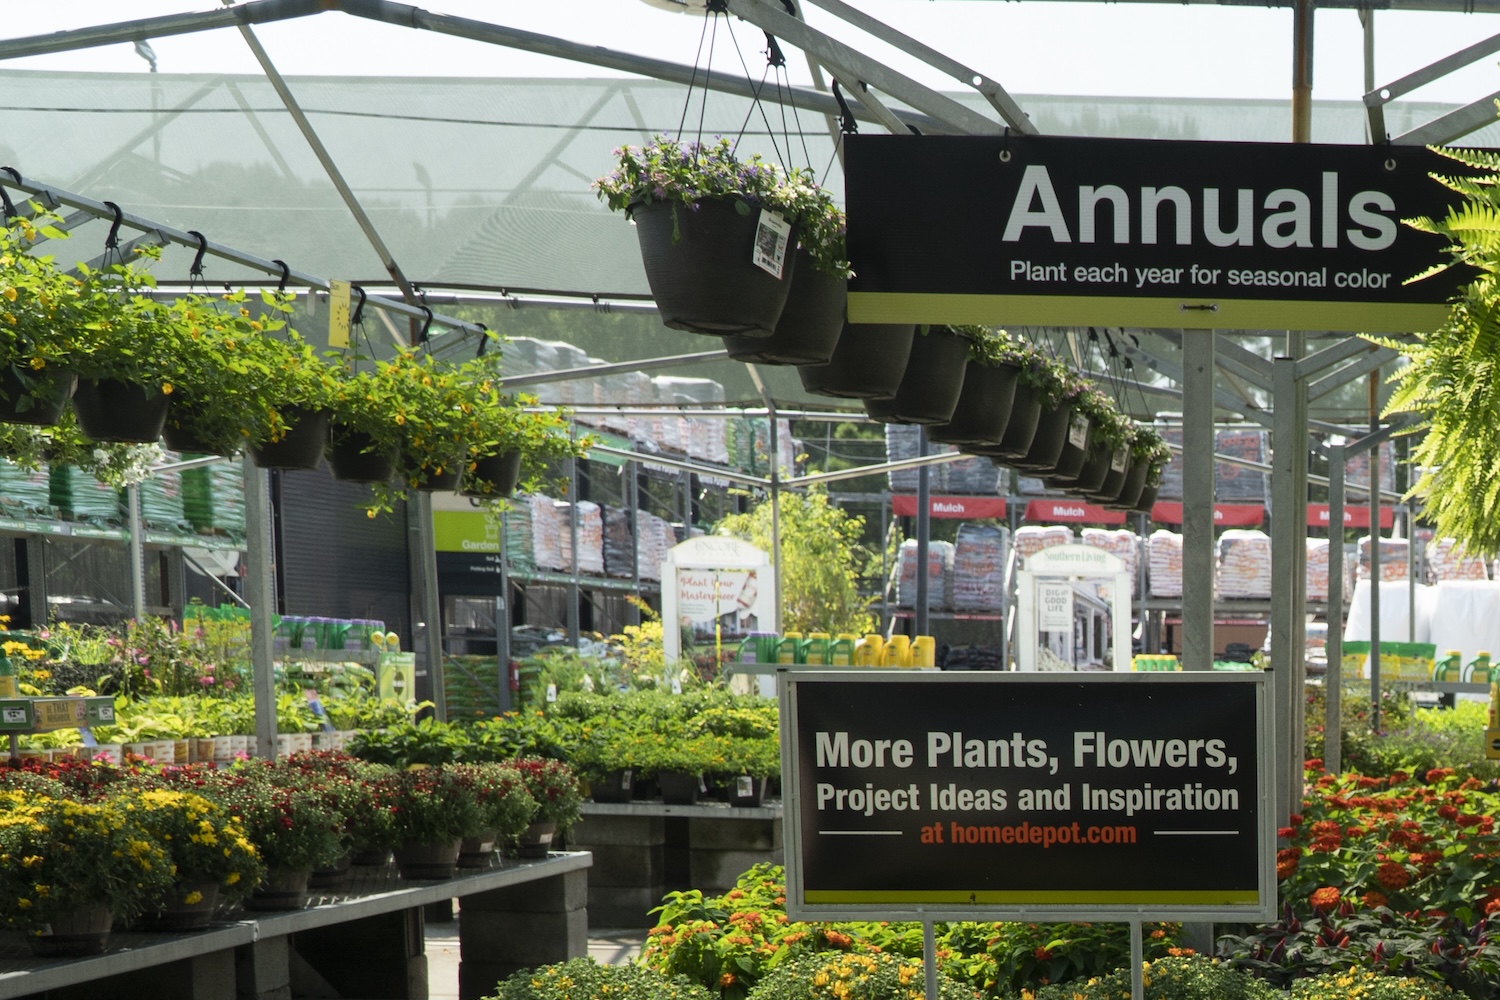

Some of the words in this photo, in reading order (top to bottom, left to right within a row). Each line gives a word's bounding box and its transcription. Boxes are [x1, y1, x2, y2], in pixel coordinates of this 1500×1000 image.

[1001, 164, 1398, 251] Annuals
[1010, 260, 1067, 283] Plant
[1074, 262, 1128, 283] each
[1135, 265, 1187, 288] year
[1190, 263, 1222, 286] for
[1228, 267, 1327, 288] seasonal
[1334, 267, 1392, 289] color
[933, 502, 965, 514] Mulch
[1052, 506, 1086, 518] Mulch
[462, 540, 499, 550] Garden
[1044, 550, 1081, 562] Southern
[1082, 551, 1107, 563] Living
[815, 731, 914, 769] More
[927, 731, 1059, 776] Plants,
[1073, 731, 1238, 775] Flowers,
[816, 783, 920, 817] Project
[930, 783, 1008, 811] Ideas
[1018, 783, 1071, 811] and
[1082, 782, 1239, 817] Inspiration
[920, 821, 944, 844] at
[951, 821, 1137, 849] homedepot.com
